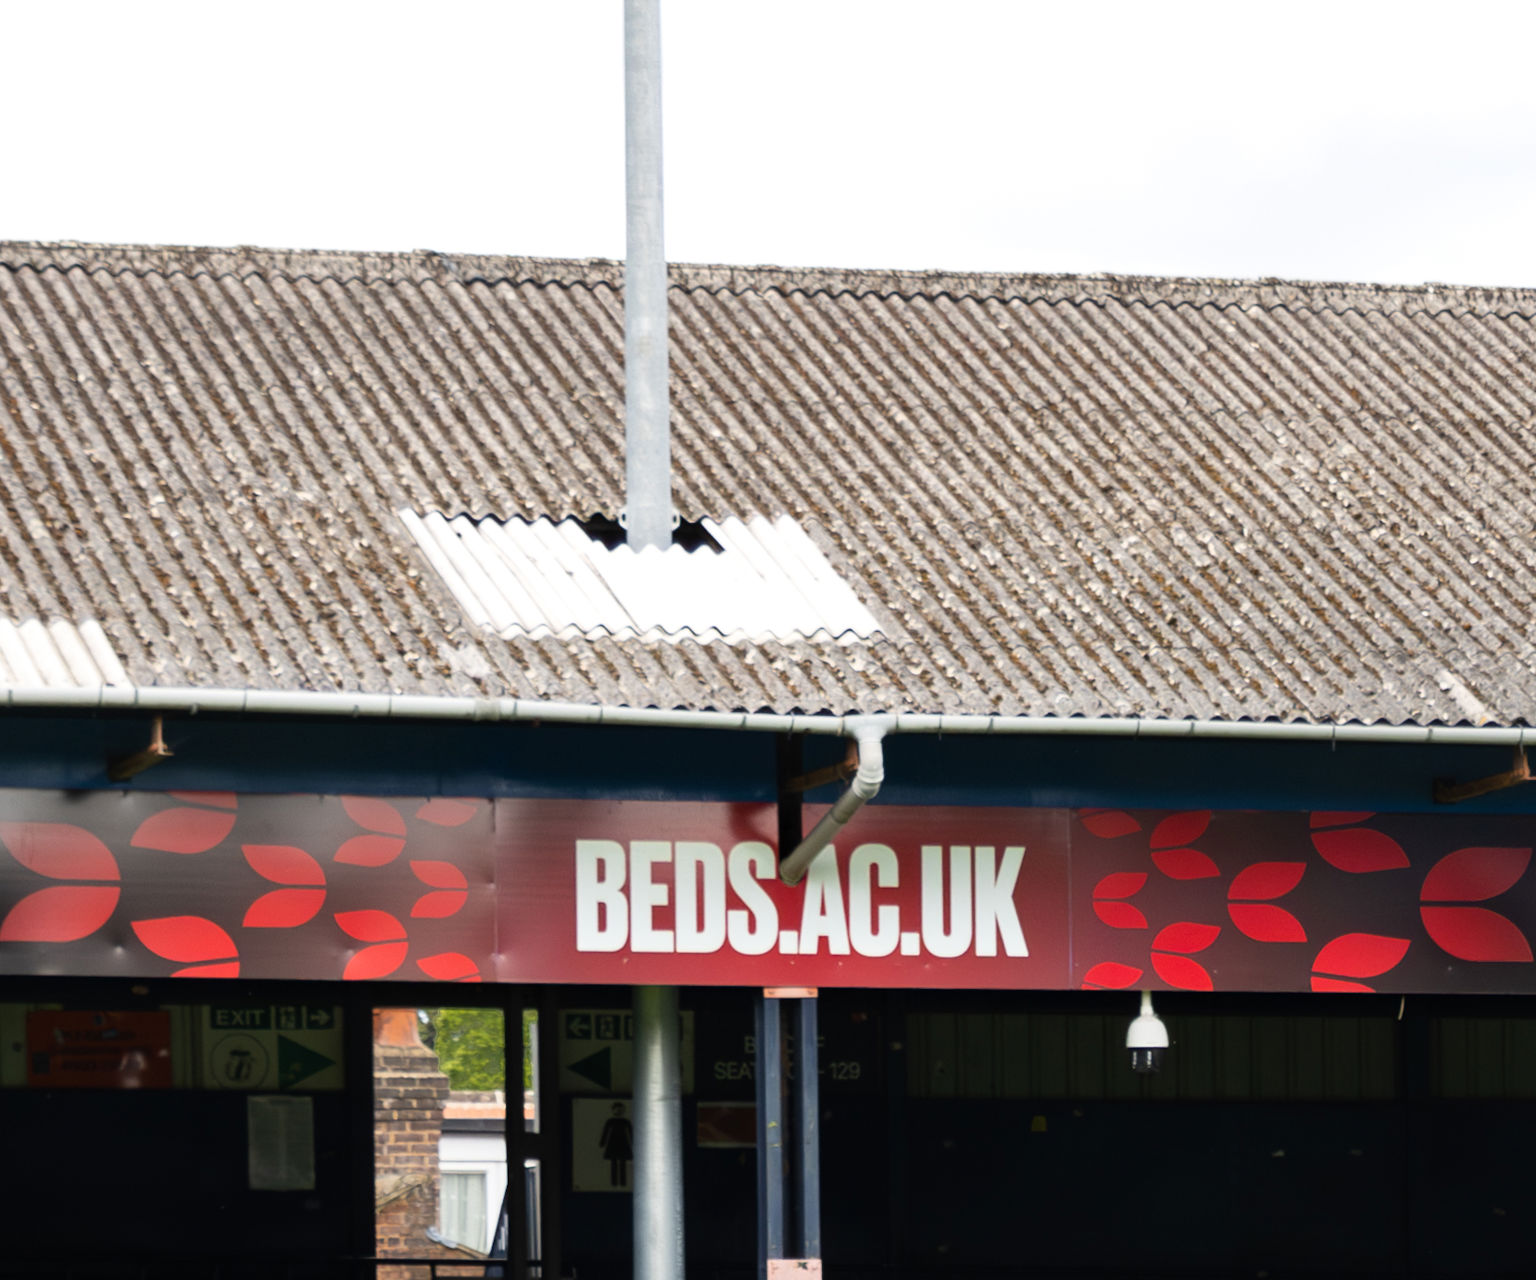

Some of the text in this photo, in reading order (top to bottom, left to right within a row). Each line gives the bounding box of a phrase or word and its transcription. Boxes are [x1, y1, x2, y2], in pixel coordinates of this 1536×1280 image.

[576, 839, 1029, 957] BEDS.AC.UK
[216, 1008, 264, 1026] EXIT
[828, 1061, 861, 1081] 129
